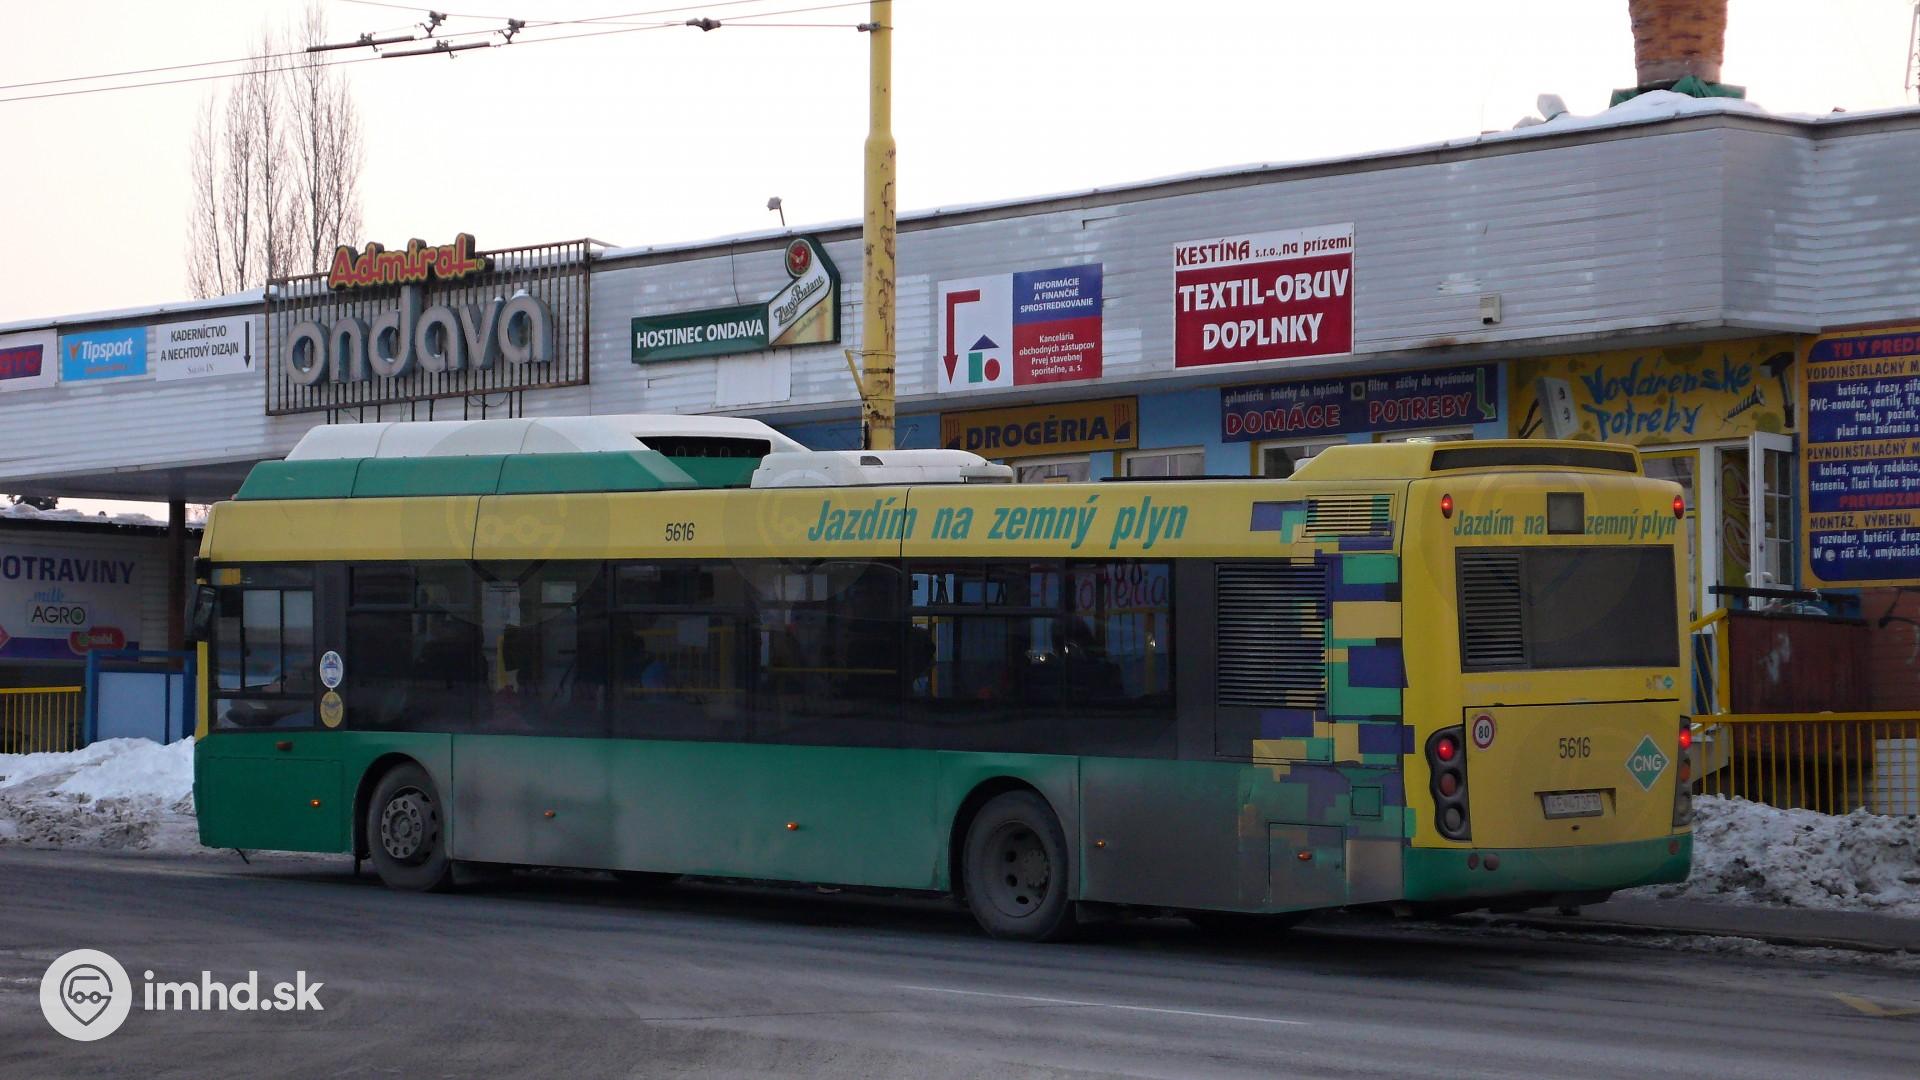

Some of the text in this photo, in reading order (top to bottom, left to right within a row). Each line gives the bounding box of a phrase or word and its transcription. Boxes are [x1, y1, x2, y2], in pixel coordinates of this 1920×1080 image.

[329, 232, 477, 288] Admiral
[1176, 239, 1250, 266] KESTÍNA
[1303, 232, 1352, 256] prízemí
[1033, 277, 1080, 290] INFORMÁCIE
[1034, 287, 1079, 301] A FINANČNÉ
[1178, 268, 1349, 312] TEXTIL-OBUV
[1020, 297, 1094, 313] SPROSTREDKOVANIE
[170, 323, 227, 343] KADERNÍCTVO
[286, 286, 553, 386] ondava
[636, 318, 764, 349] HOSTINEC ONDAVA
[1039, 332, 1074, 343] Kancelária
[1203, 312, 1324, 351] DOPLNKY
[82, 336, 133, 363] Tipsport
[160, 342, 239, 361] A NECHTOVÝ DIZAJN
[1019, 343, 1060, 356] obchodných
[1031, 353, 1083, 366] Prvej stavebnej
[1300, 384, 1310, 397] do
[1421, 374, 1432, 387] do
[1226, 392, 1472, 436] DOMÁCE POTREBY
[966, 415, 1109, 450] DROGÉRIA
[1862, 427, 1872, 435] na
[664, 522, 695, 542] 5616
[807, 494, 1189, 550] Jazdím na zemný plyn
[1453, 508, 1677, 540] Jazdím na zemný plyn
[0, 555, 135, 584] OTRAVINY
[31, 605, 86, 625] AGRO
[1478, 725, 1490, 739] 80
[1558, 736, 1591, 759] 5616
[1633, 754, 1662, 772] CNG
